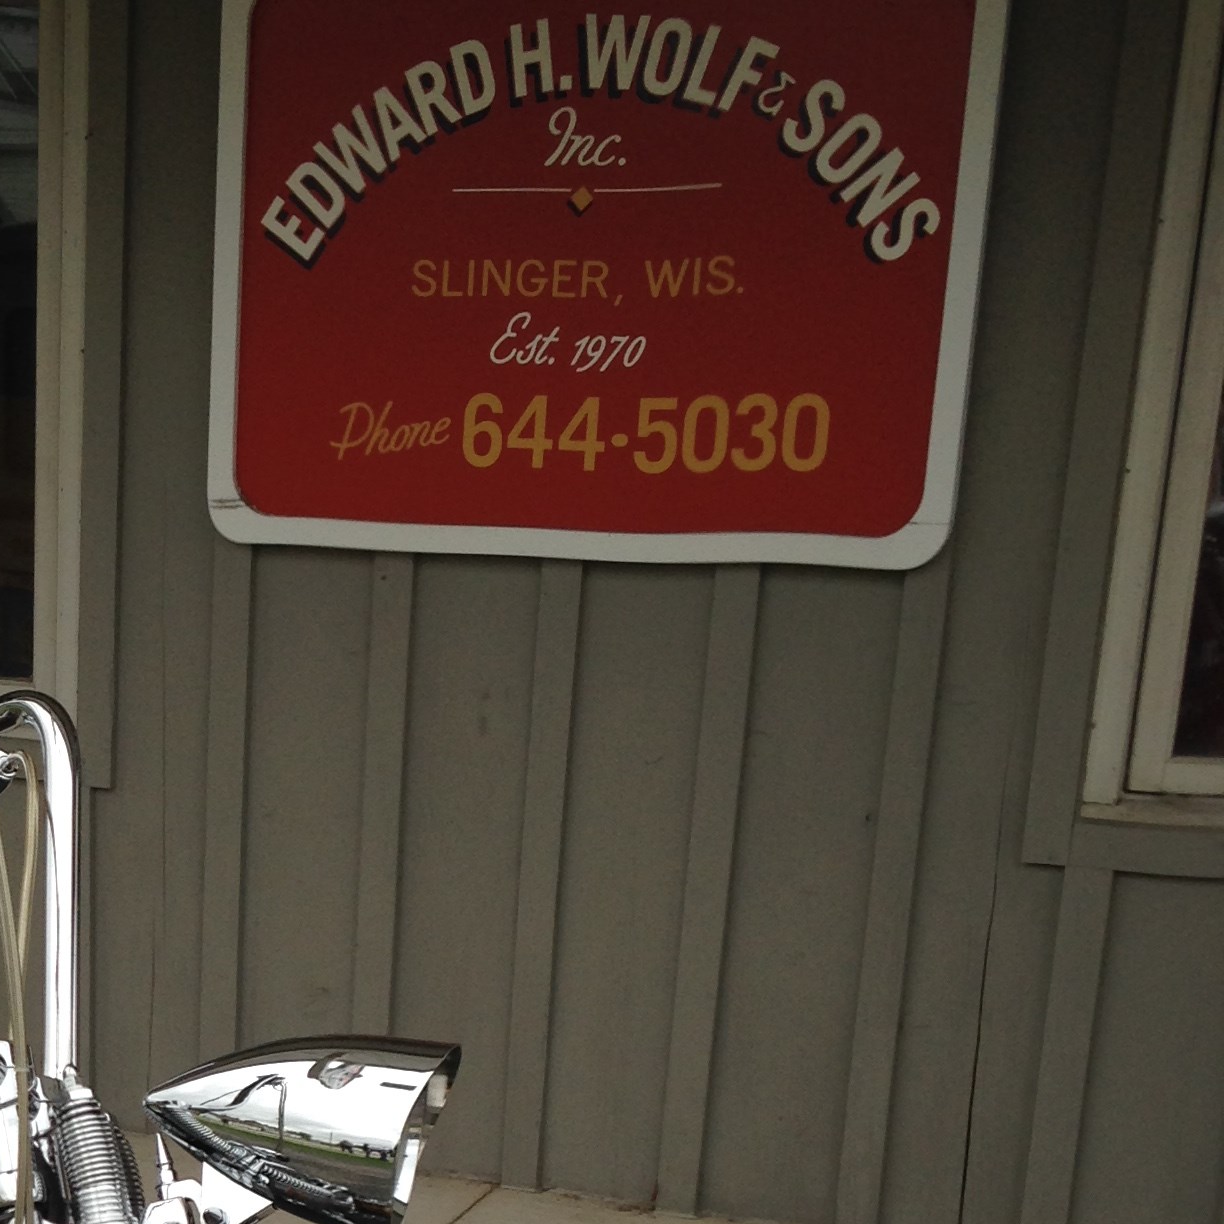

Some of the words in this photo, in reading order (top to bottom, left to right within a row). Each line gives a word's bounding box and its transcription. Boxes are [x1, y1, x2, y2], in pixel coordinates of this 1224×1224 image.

[260, 39, 496, 265] EDWARD
[510, 18, 573, 102] H.
[584, 14, 780, 114] WOLF
[781, 79, 941, 264] SONS
[544, 107, 627, 167] Inc.
[411, 258, 624, 307] SLINGER,
[645, 256, 745, 297] WIS.
[489, 312, 557, 365] Est.
[571, 335, 647, 372] 1970
[329, 401, 451, 460] Phone
